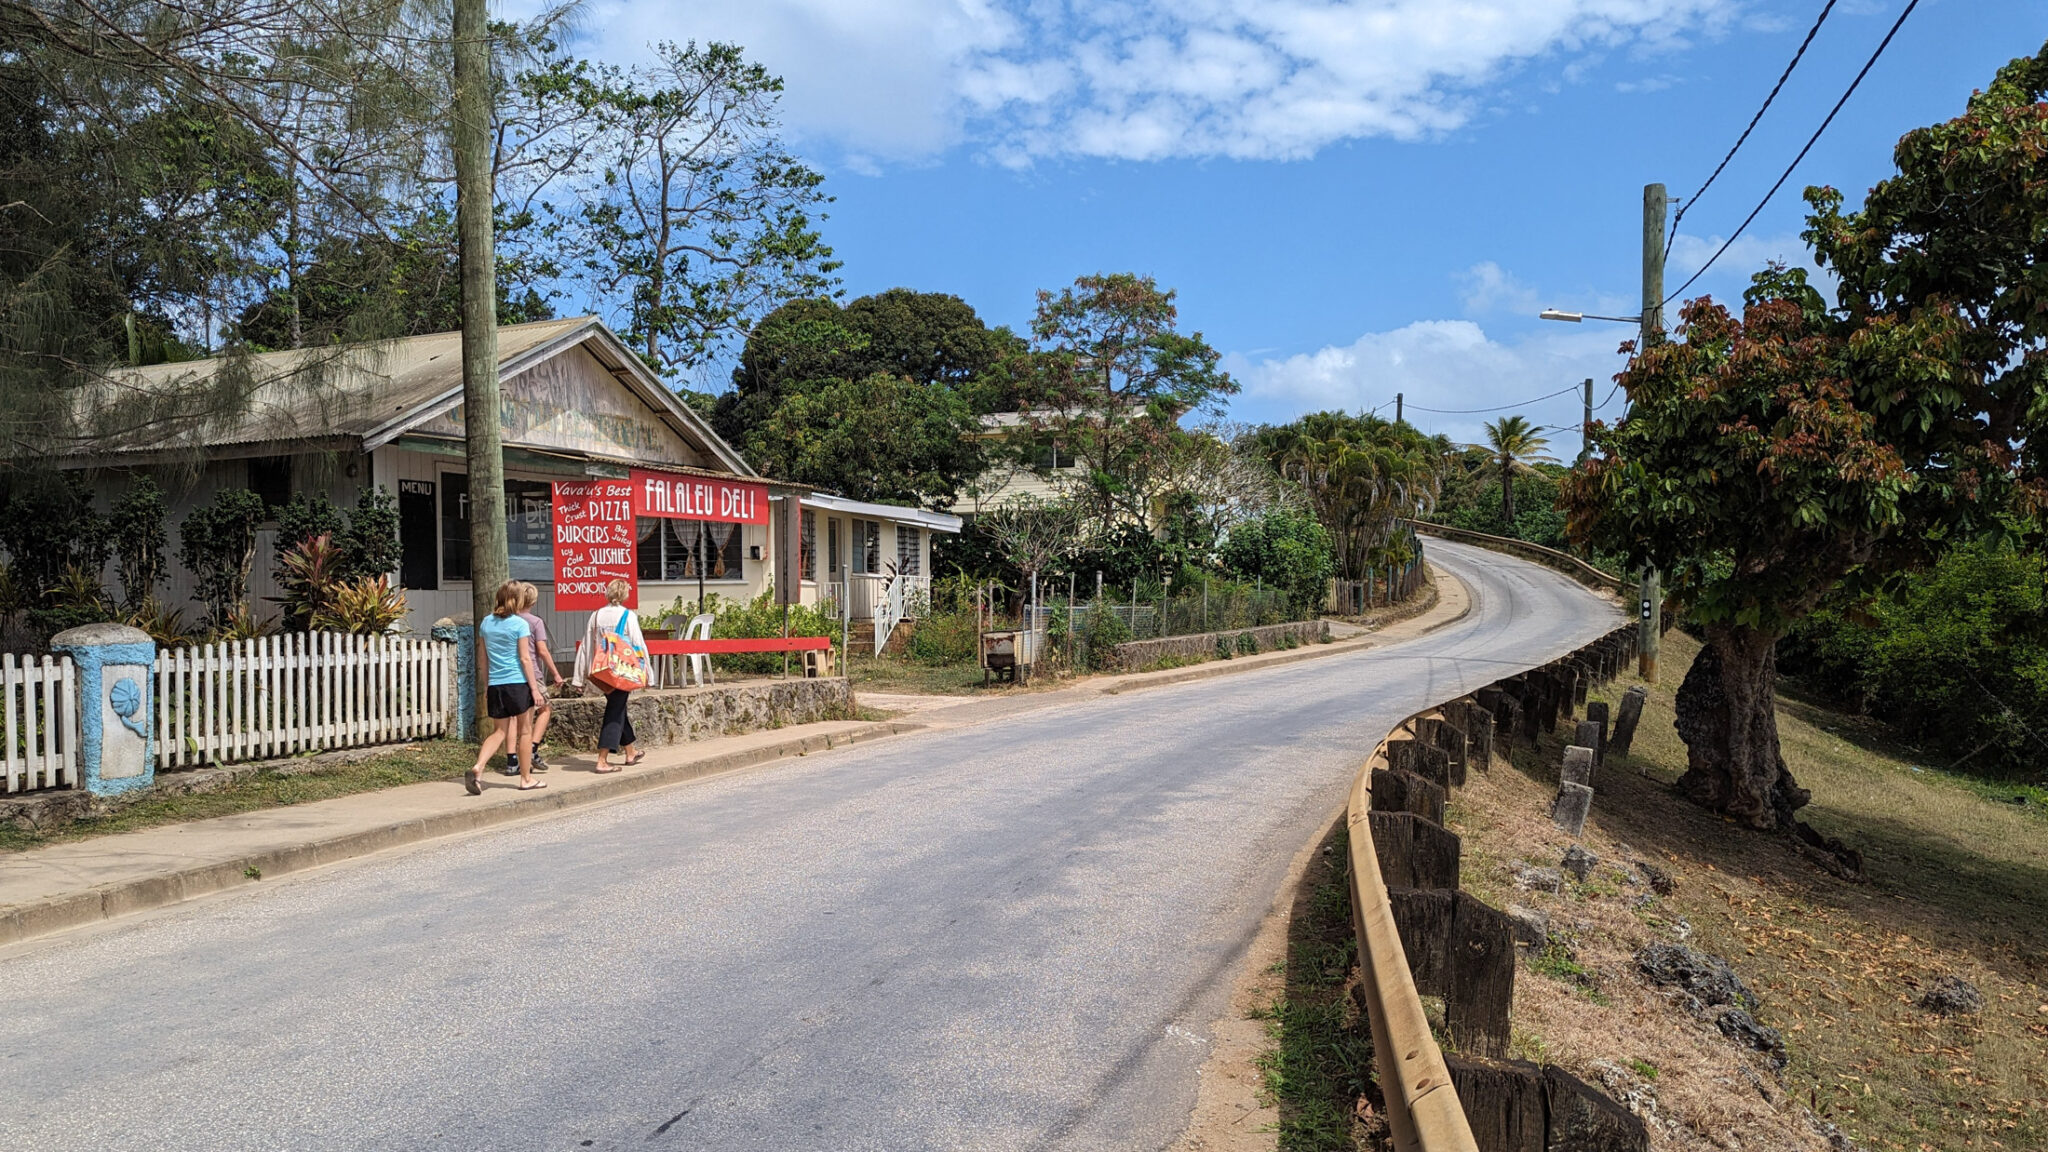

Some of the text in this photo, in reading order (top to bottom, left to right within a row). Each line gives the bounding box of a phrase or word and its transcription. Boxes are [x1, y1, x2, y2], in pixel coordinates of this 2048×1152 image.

[401, 481, 432, 495] MENU
[554, 481, 632, 497] Vava'u's Best
[645, 478, 754, 519] FALALEU DELI
[525, 498, 553, 524] DEL
[558, 501, 581, 514] Thick
[589, 500, 631, 521] PIZZA
[565, 510, 587, 523] Crust
[557, 524, 610, 544] BURGERS
[614, 524, 628, 536] Big
[611, 534, 632, 547] Juicy
[566, 552, 584, 566] Cold
[589, 547, 632, 565] SLUSHIES
[562, 566, 598, 578] FROZEN
[557, 582, 607, 595] PROVISIONS
